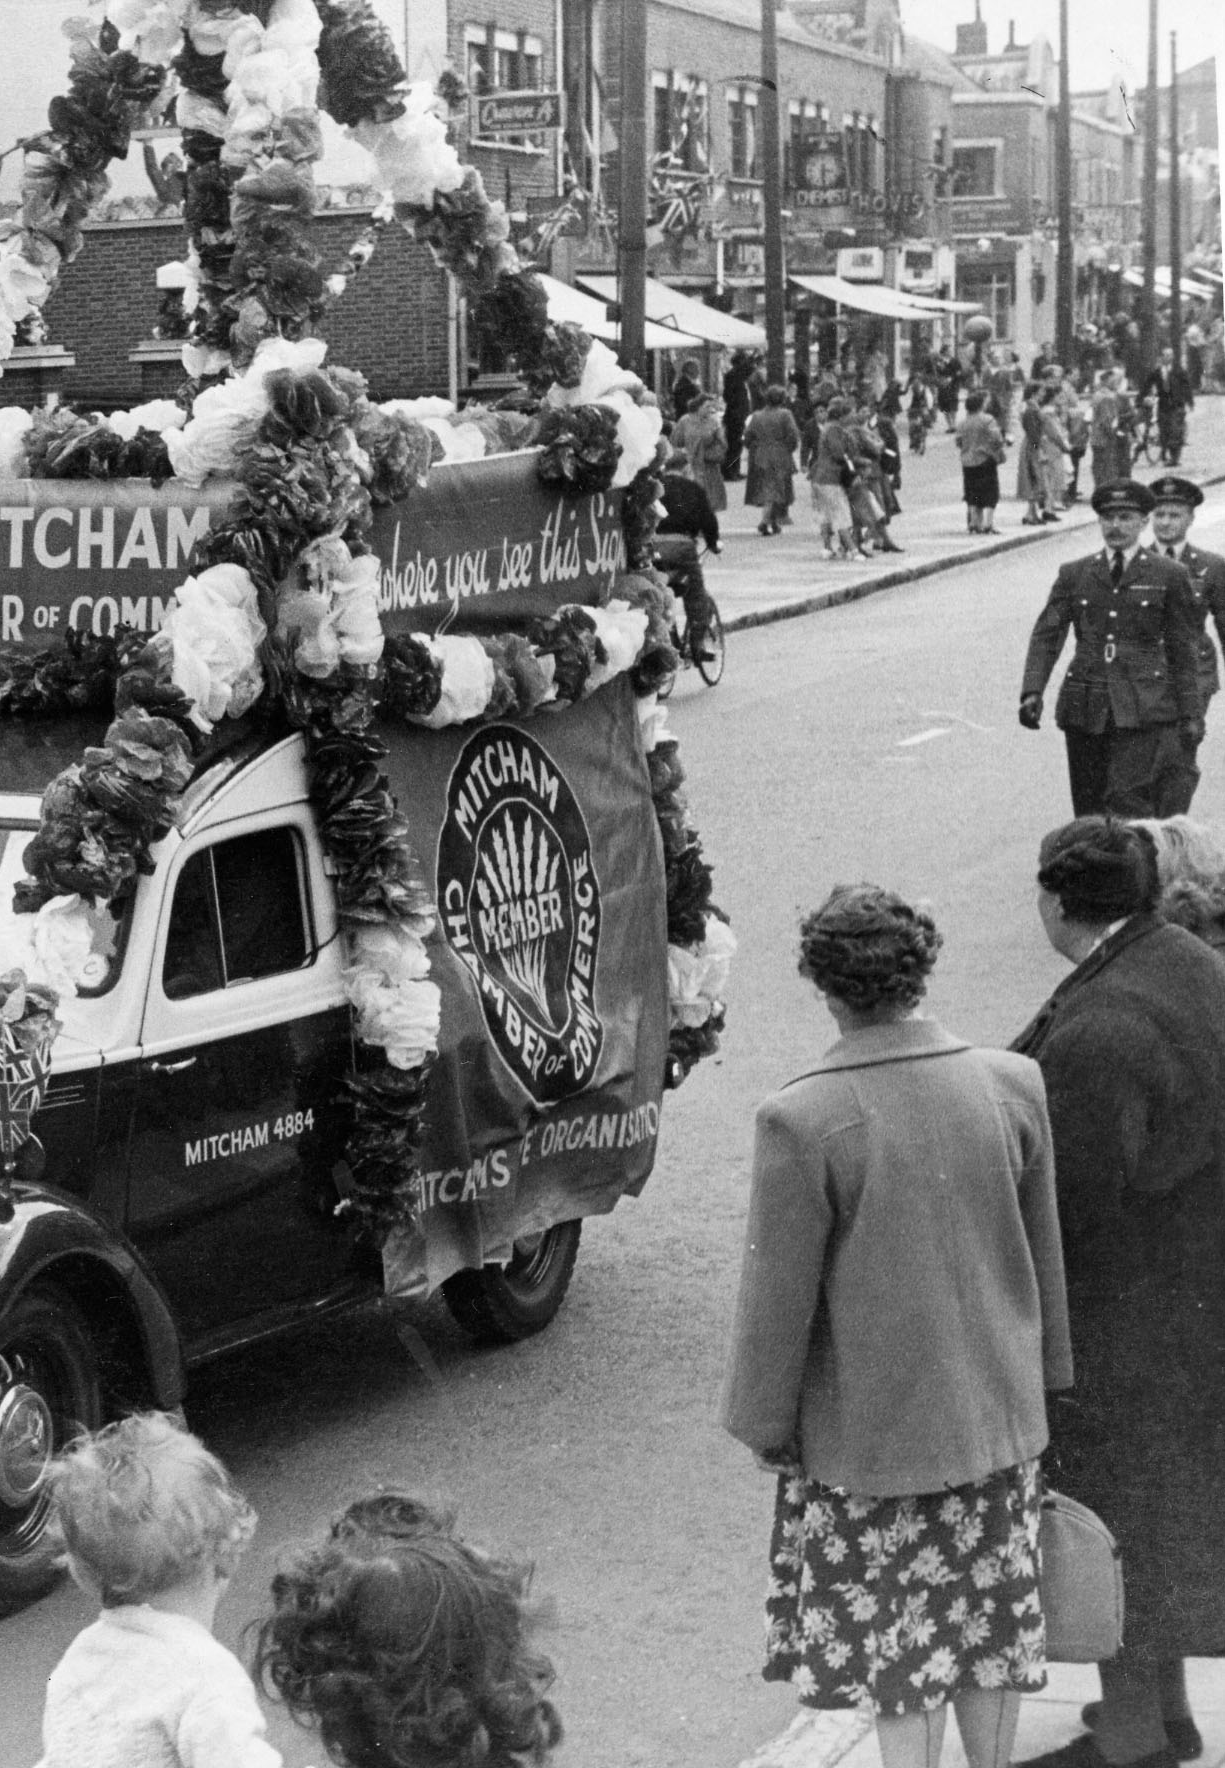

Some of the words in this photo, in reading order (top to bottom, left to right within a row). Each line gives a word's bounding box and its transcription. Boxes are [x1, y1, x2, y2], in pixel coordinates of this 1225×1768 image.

[444, 549, 491, 637] you
[496, 537, 533, 592] see
[540, 496, 580, 585] this
[33, 604, 60, 629] OF
[69, 595, 177, 638] COMM
[454, 740, 559, 843] MITCHAM
[478, 889, 565, 955] MEMBER
[445, 878, 549, 1082] CHAMBER
[544, 1053, 567, 1076] OF
[569, 849, 600, 1081] COMMERCE
[185, 1121, 269, 1167] MITCHAM
[273, 1108, 315, 1141] 4884
[541, 1101, 659, 1157] ORGANISATIO
